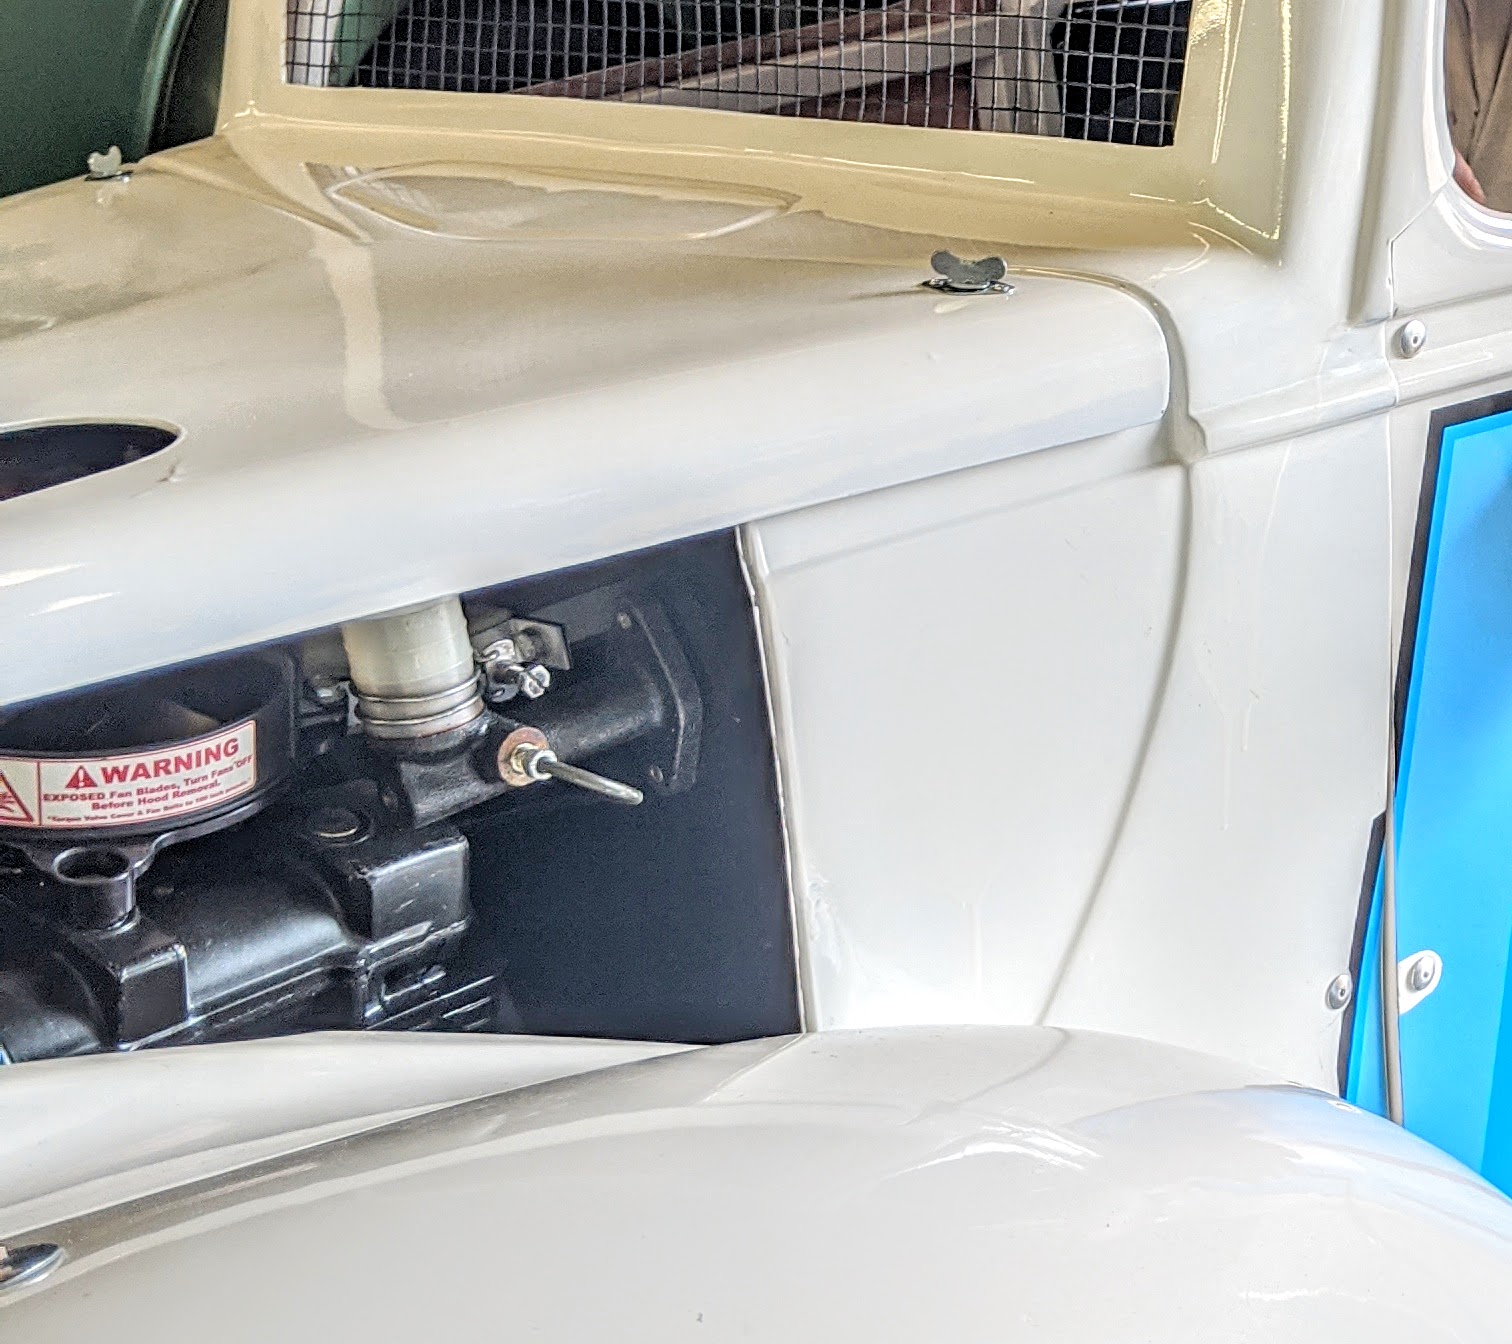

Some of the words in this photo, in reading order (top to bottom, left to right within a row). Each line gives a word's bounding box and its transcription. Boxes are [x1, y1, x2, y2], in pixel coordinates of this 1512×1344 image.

[101, 737, 240, 785] WARNING
[42, 791, 106, 802] EXPOSED
[109, 790, 133, 799] Fan
[136, 782, 181, 796] Blades,
[183, 773, 209, 787] Turn
[91, 800, 134, 811] Before
[137, 792, 169, 806] Hood
[172, 779, 222, 799] Removal.
